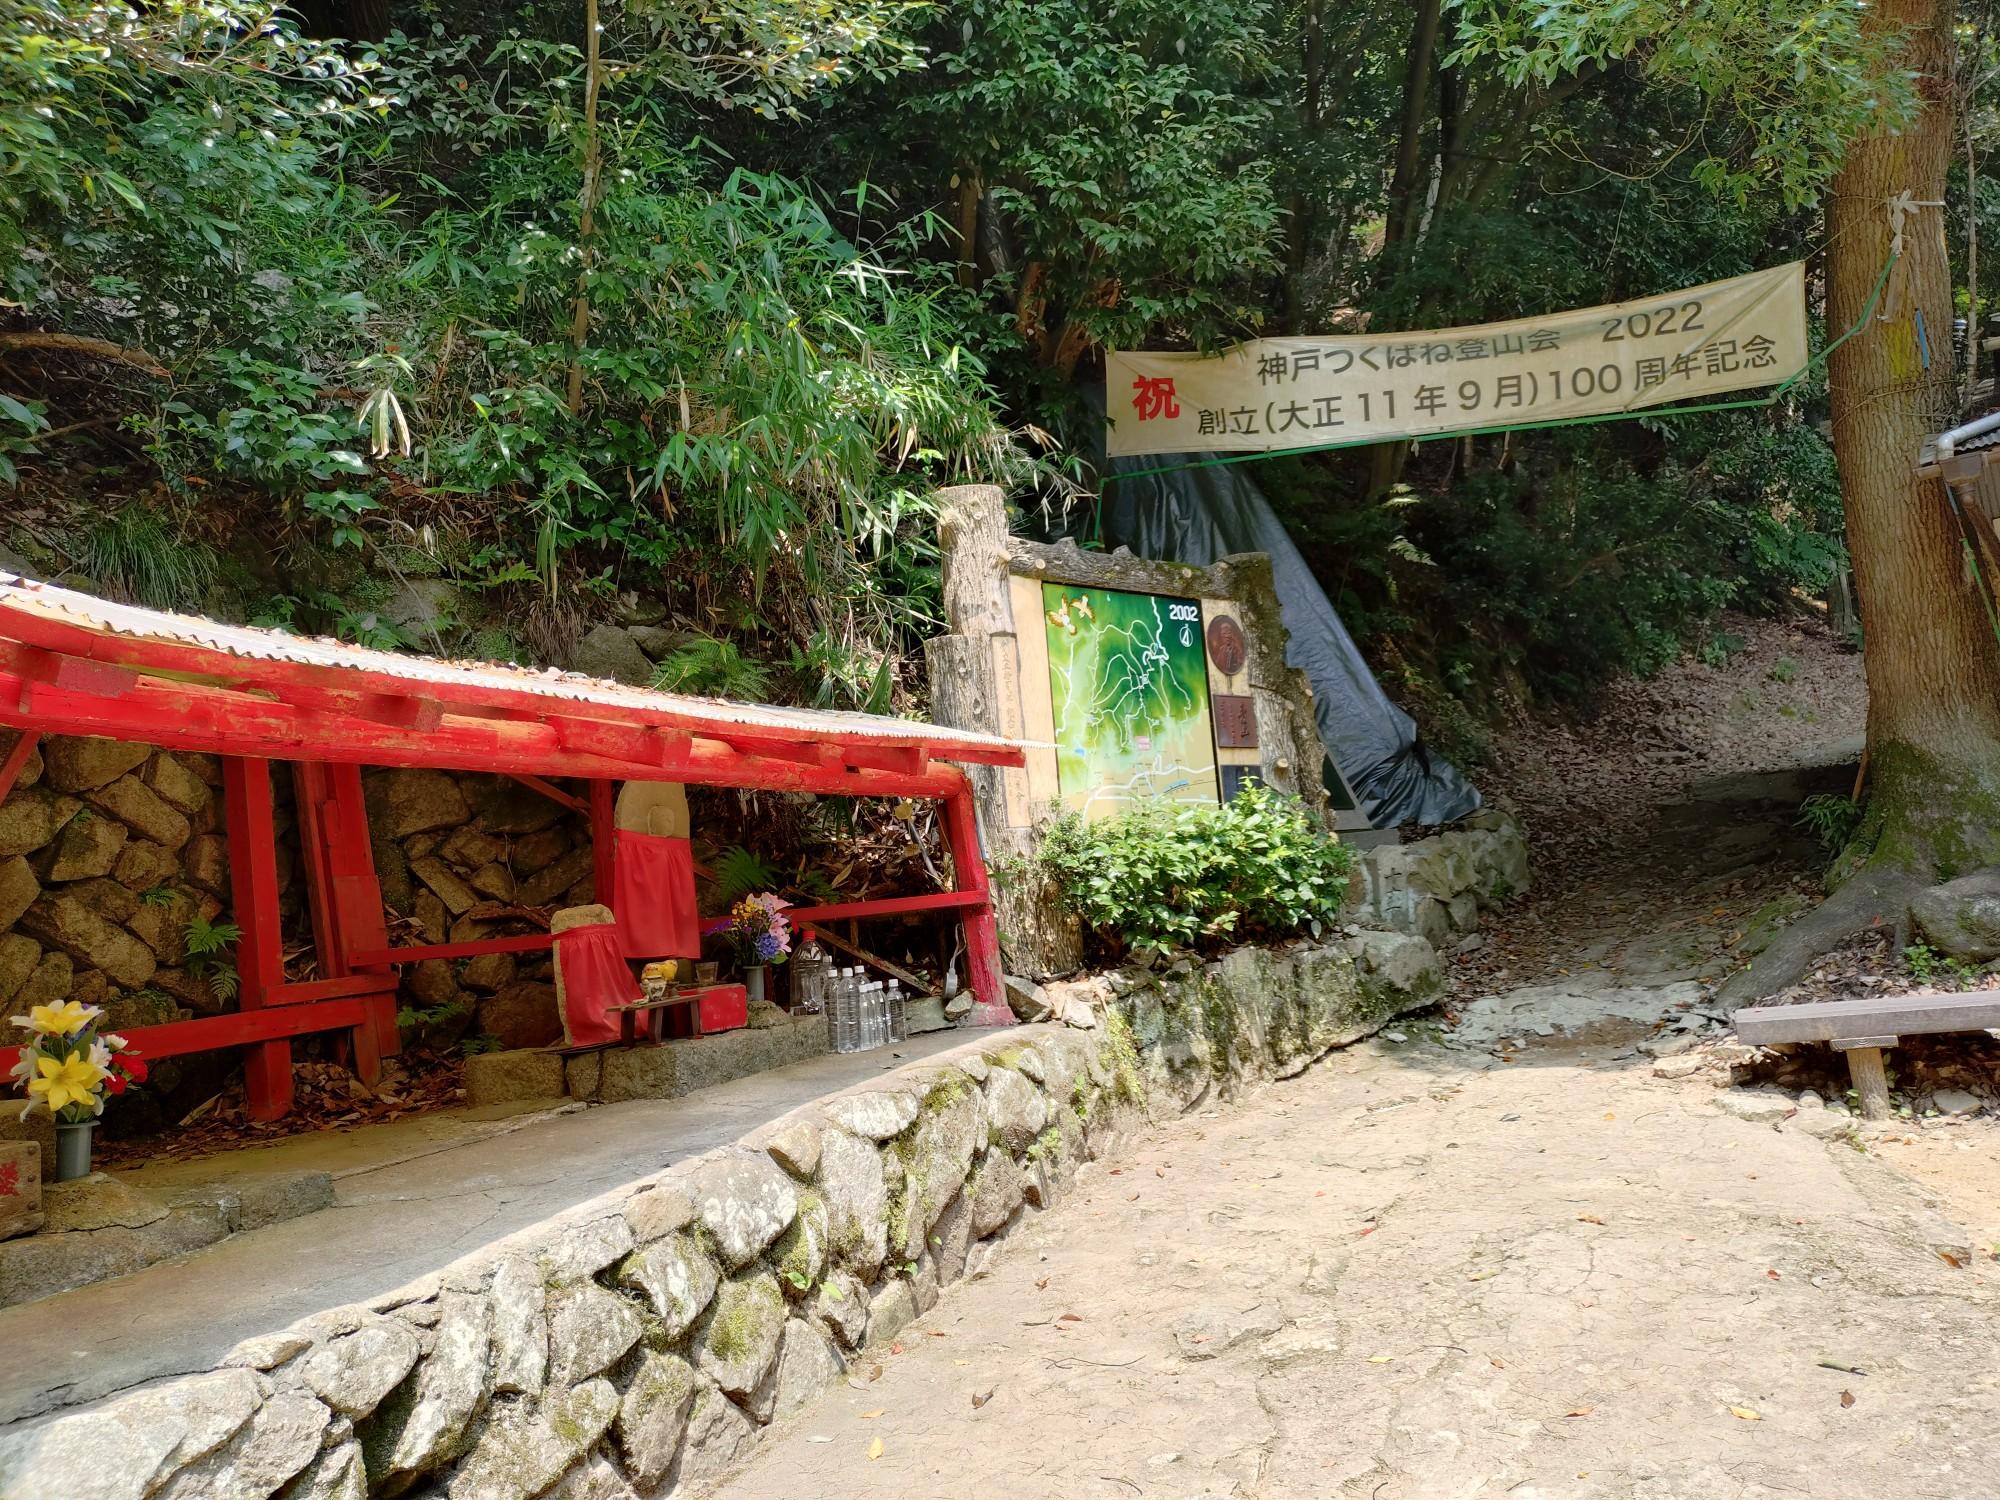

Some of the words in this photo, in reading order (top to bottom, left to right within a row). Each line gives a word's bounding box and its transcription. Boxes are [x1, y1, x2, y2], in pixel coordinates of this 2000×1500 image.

[1257, 329, 1560, 386] 神戸つくばね登山会
[1600, 301, 1704, 343] 2022
[1132, 374, 1180, 421] 祝
[1168, 604, 1199, 622] 2002
